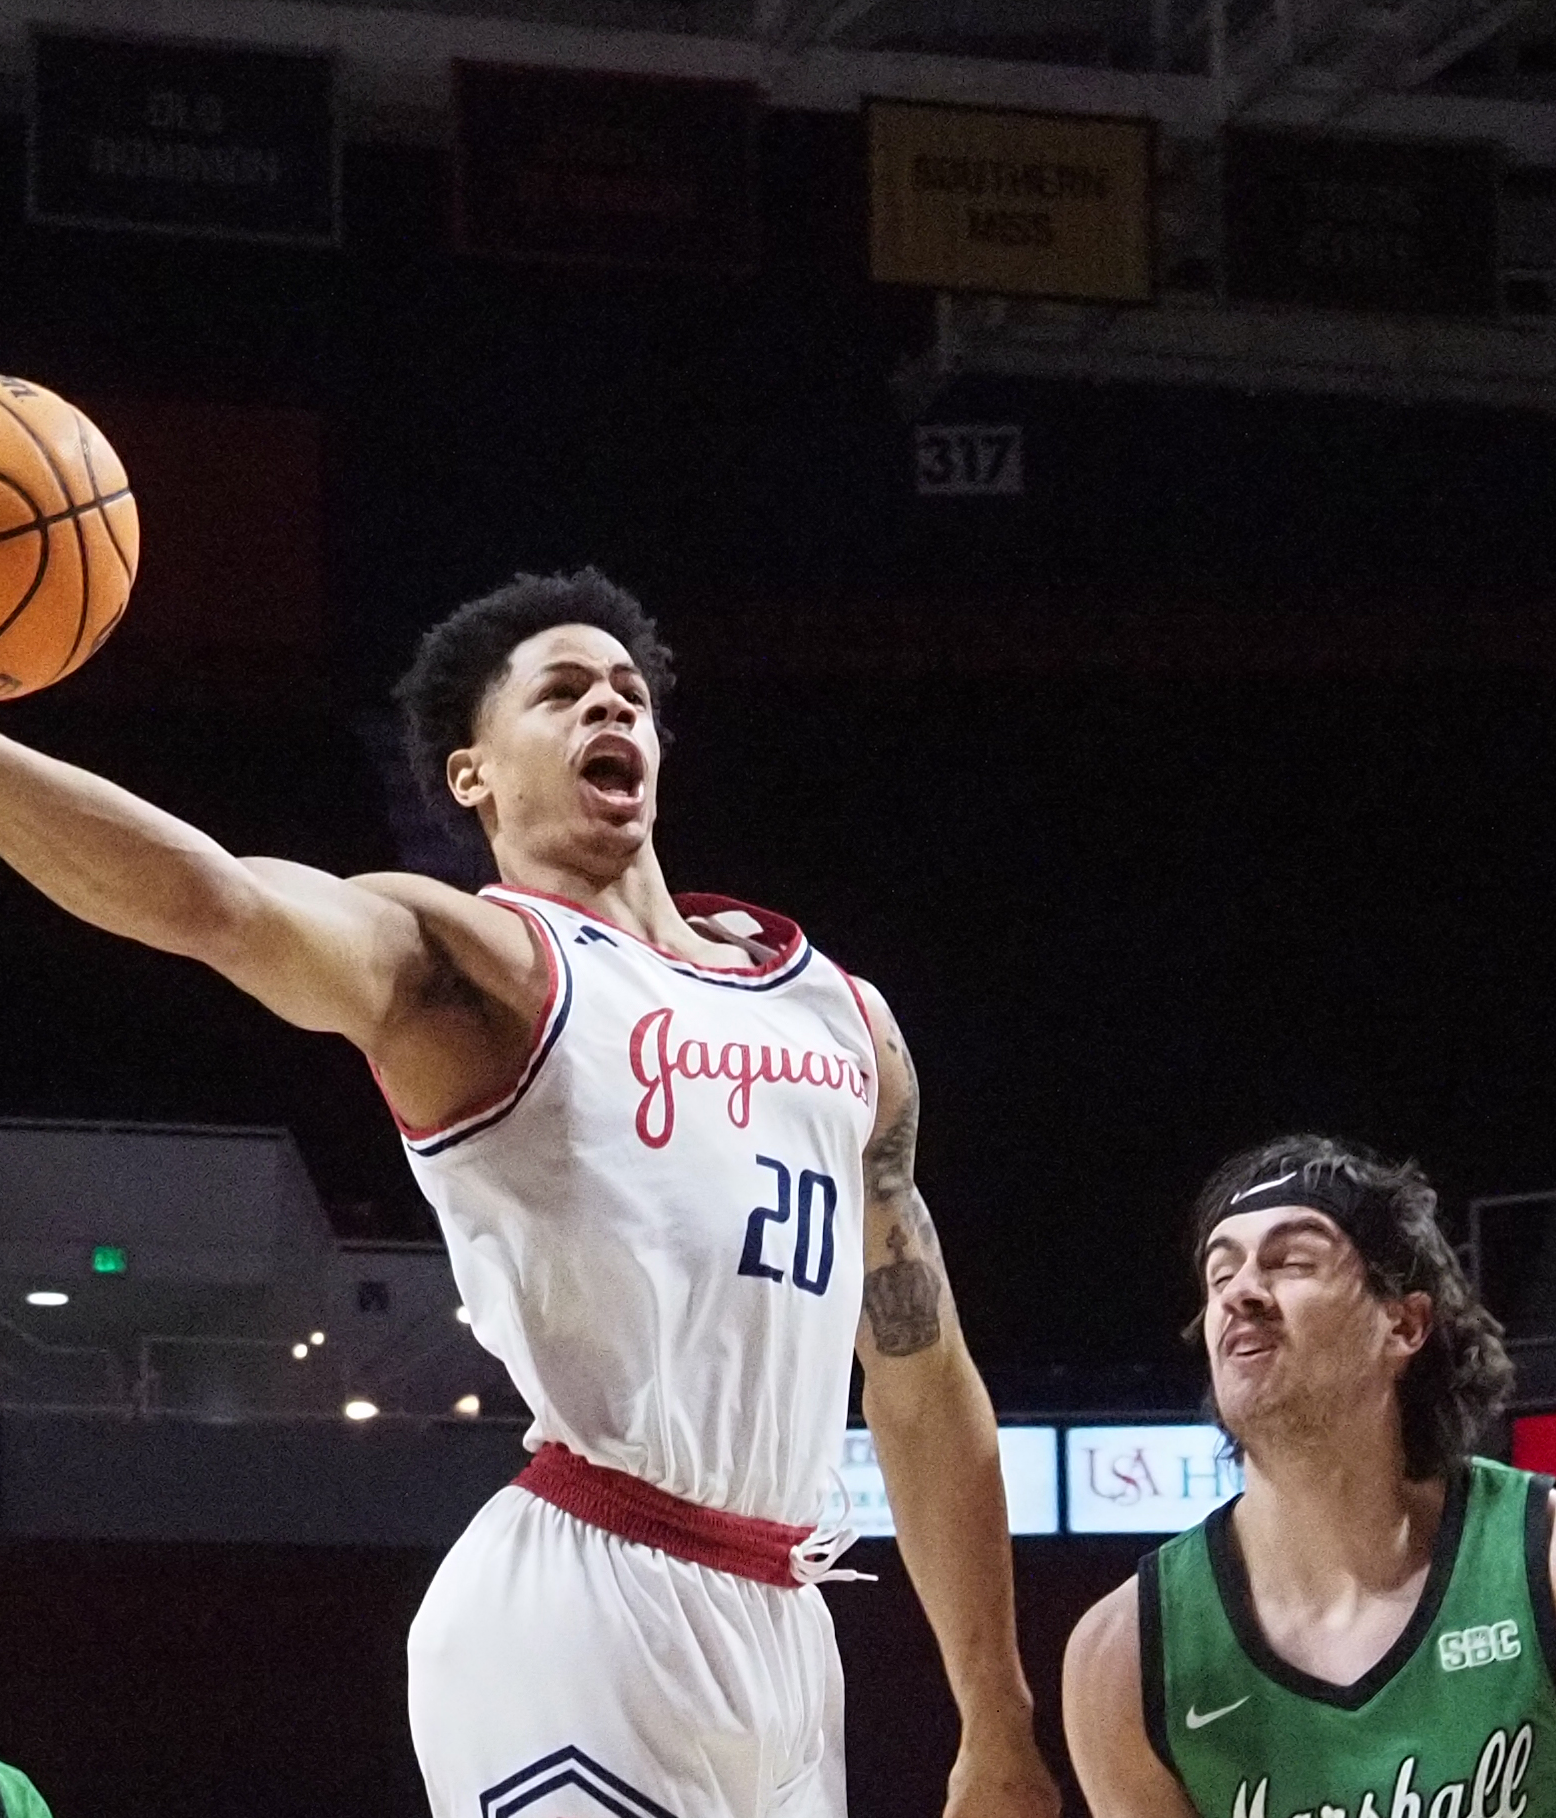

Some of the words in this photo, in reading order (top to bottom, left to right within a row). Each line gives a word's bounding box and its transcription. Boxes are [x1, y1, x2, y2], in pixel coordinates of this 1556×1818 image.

[912, 154, 1109, 199] SOUTHERN
[968, 210, 1055, 247] MISS
[922, 433, 1016, 484] 317
[737, 1153, 838, 1297] 20
[1437, 1619, 1521, 1672] SBC
